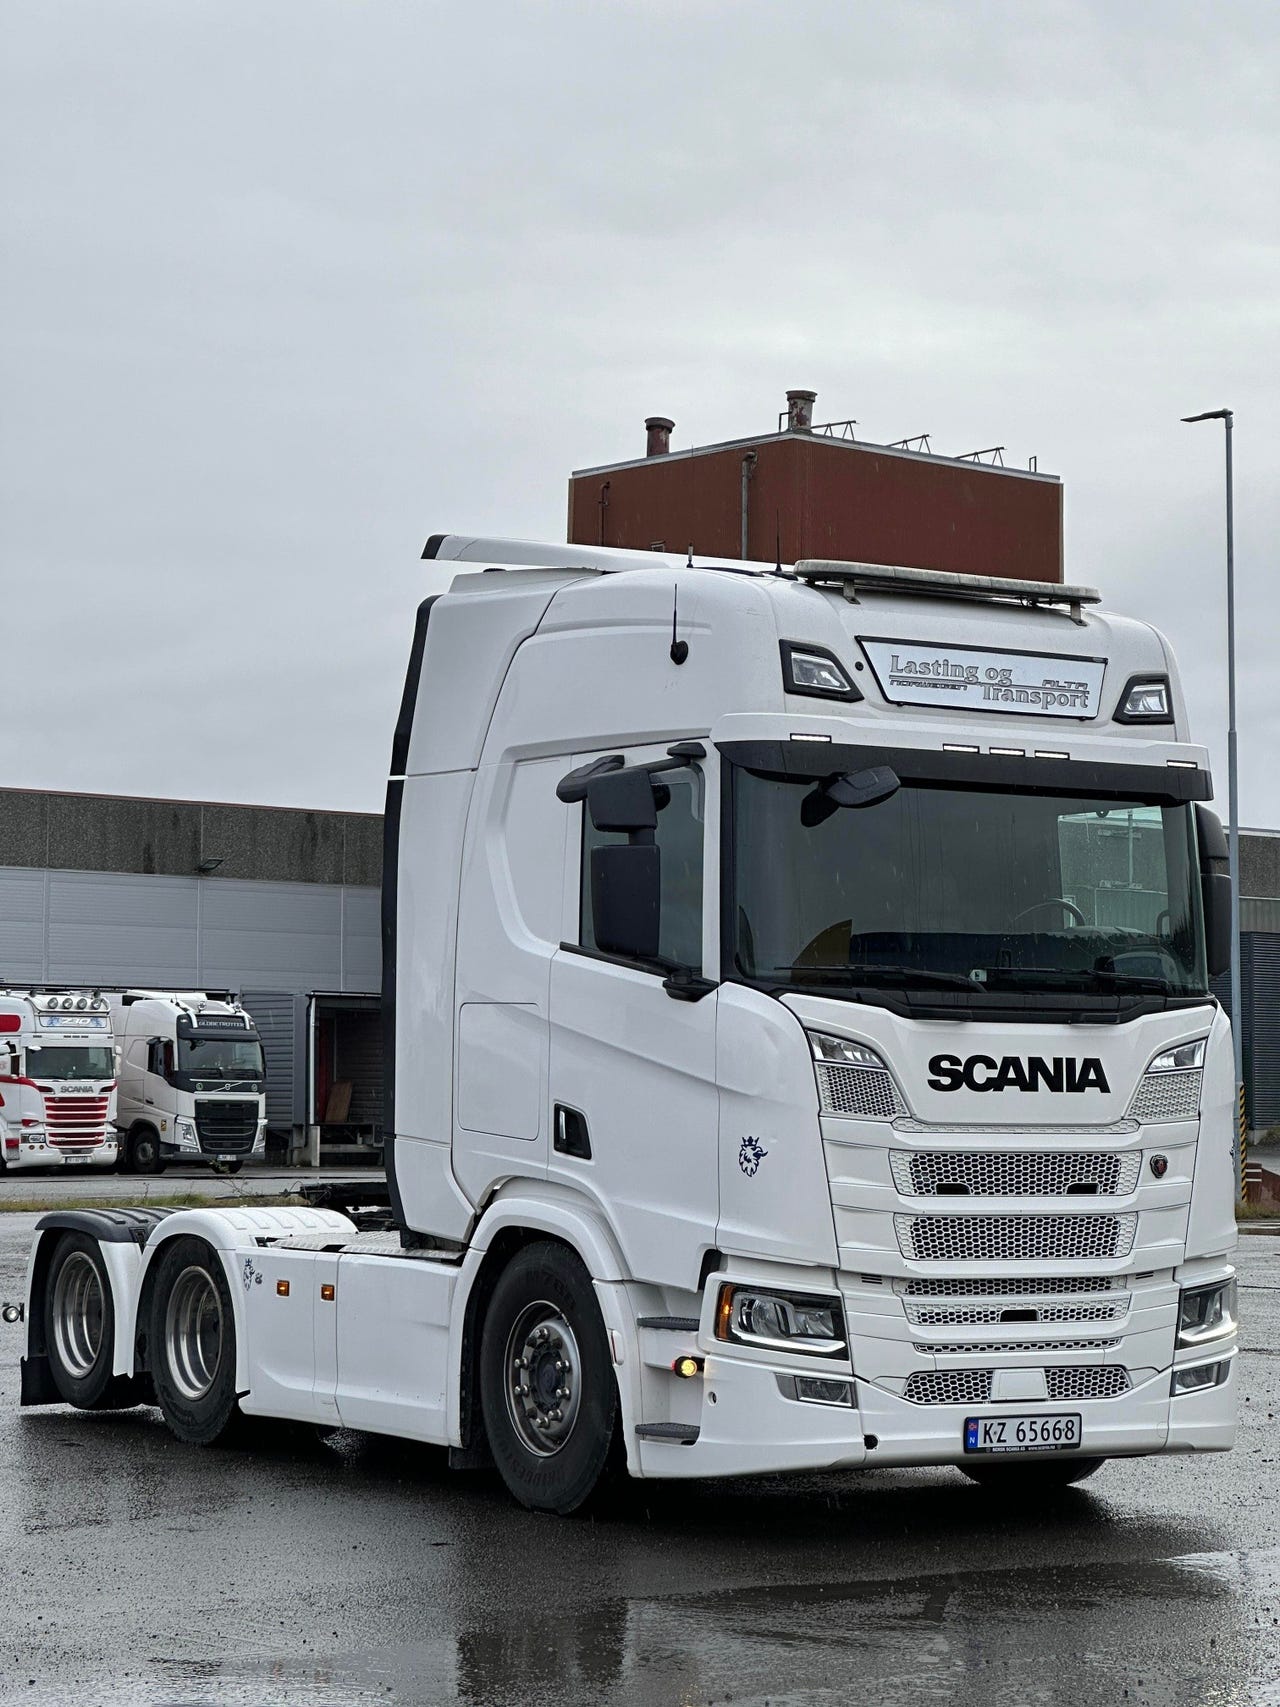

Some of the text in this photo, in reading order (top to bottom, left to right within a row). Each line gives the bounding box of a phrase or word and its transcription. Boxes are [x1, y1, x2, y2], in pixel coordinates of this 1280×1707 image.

[890, 655, 1013, 686] Lasting og
[979, 683, 1089, 709] Transport
[1041, 679, 1089, 689] ALTA
[927, 1054, 1111, 1093] SCANIA
[60, 1085, 94, 1093] SCANIA
[969, 1436, 975, 1444] N
[983, 1420, 1075, 1444] KZ 65668
